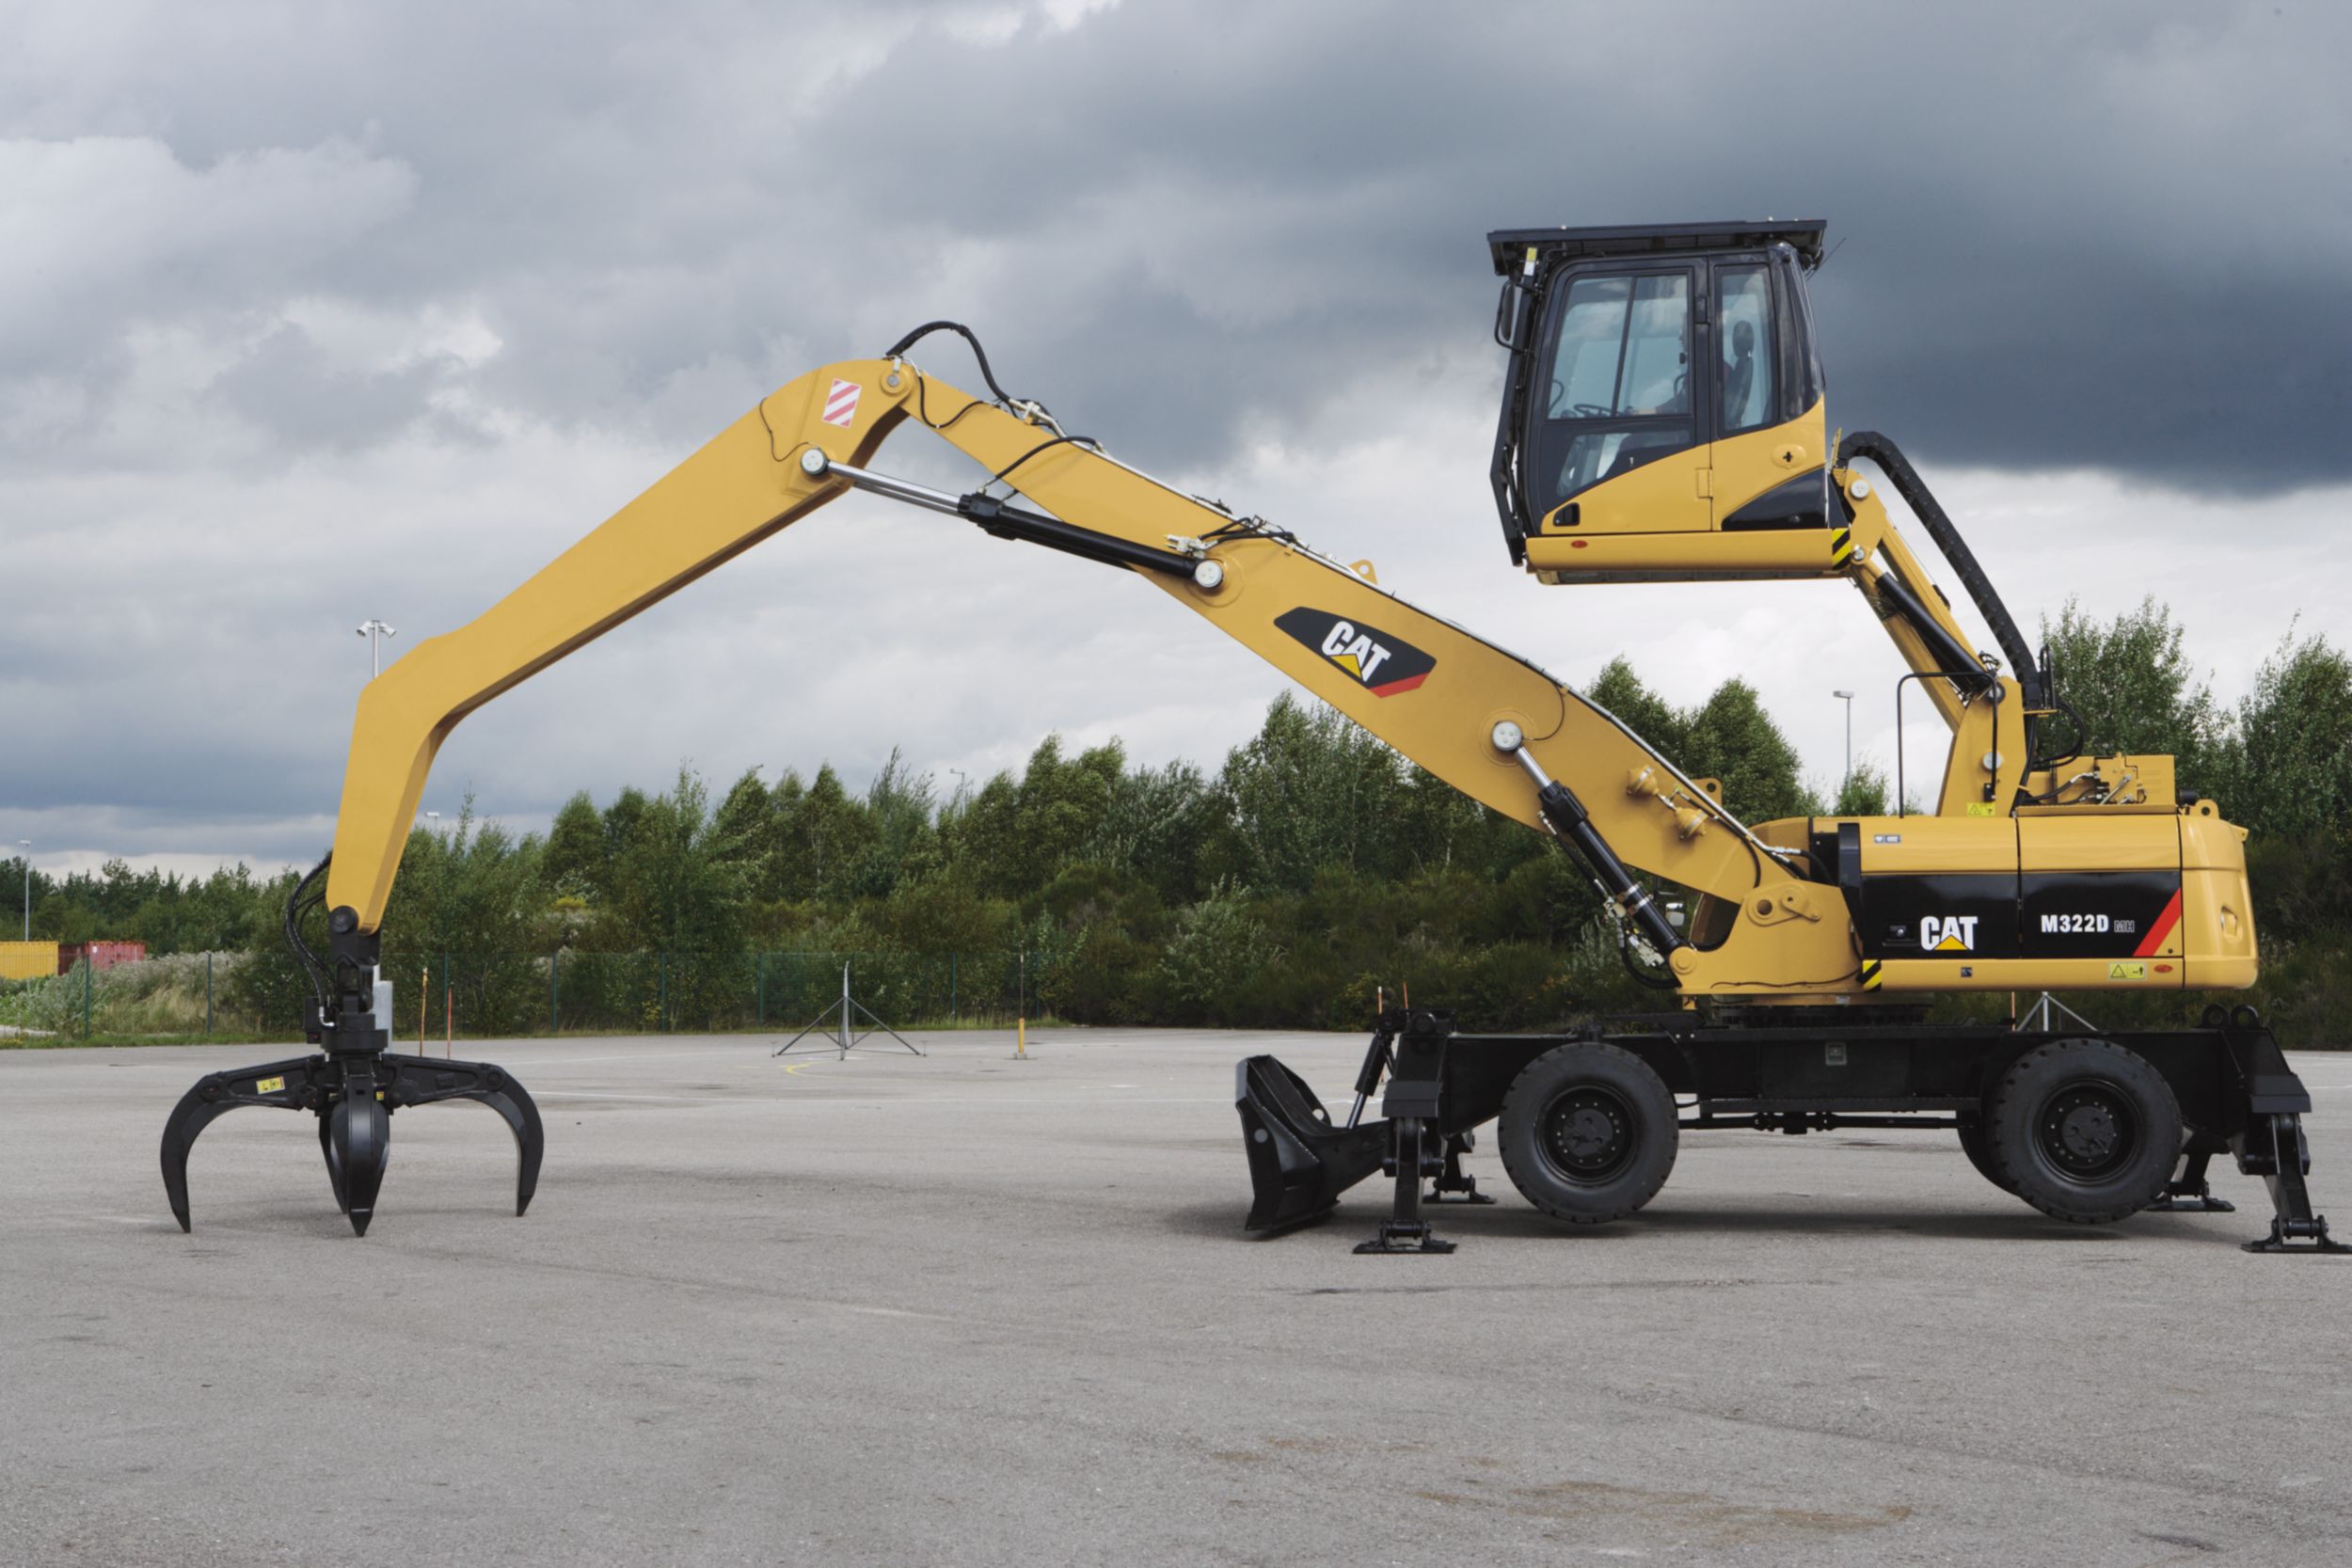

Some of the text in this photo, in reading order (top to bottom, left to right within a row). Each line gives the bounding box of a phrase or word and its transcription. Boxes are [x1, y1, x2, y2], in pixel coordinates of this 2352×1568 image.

[1322, 621, 1391, 682] CAT
[1920, 916, 1978, 950] CAT
[2041, 914, 2135, 932] M322D MH
